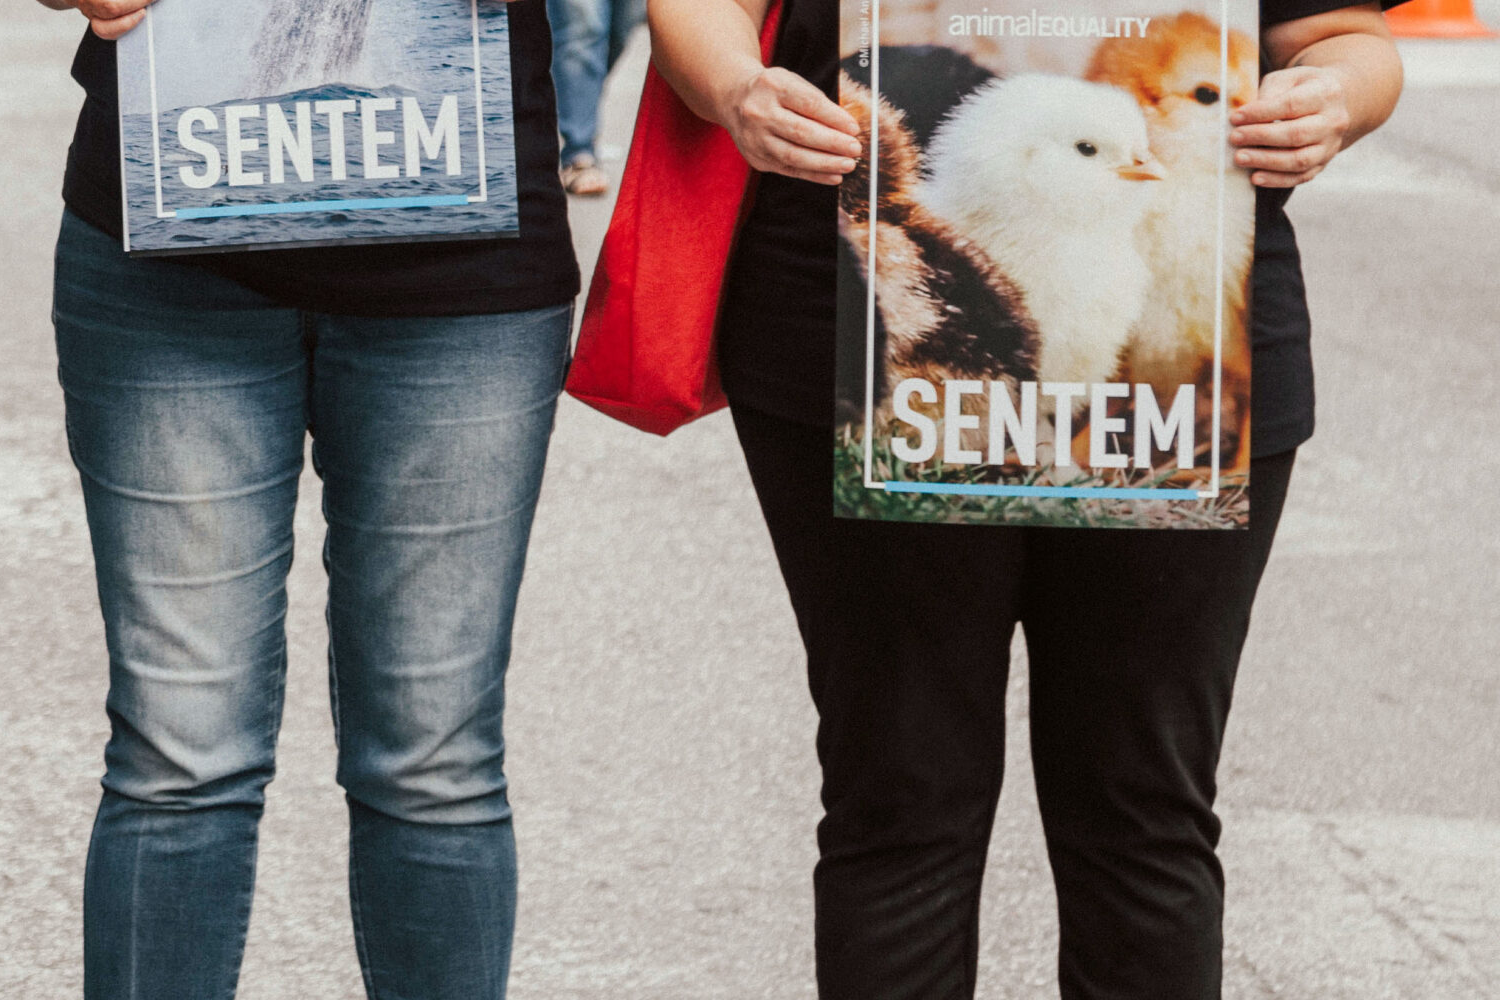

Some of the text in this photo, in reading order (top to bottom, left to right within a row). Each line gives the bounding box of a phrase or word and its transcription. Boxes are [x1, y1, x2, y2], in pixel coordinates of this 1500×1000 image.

[948, 8, 1151, 39] animalEQUALITY
[177, 95, 462, 190] SENTEM
[891, 377, 1196, 470] SENTEM
